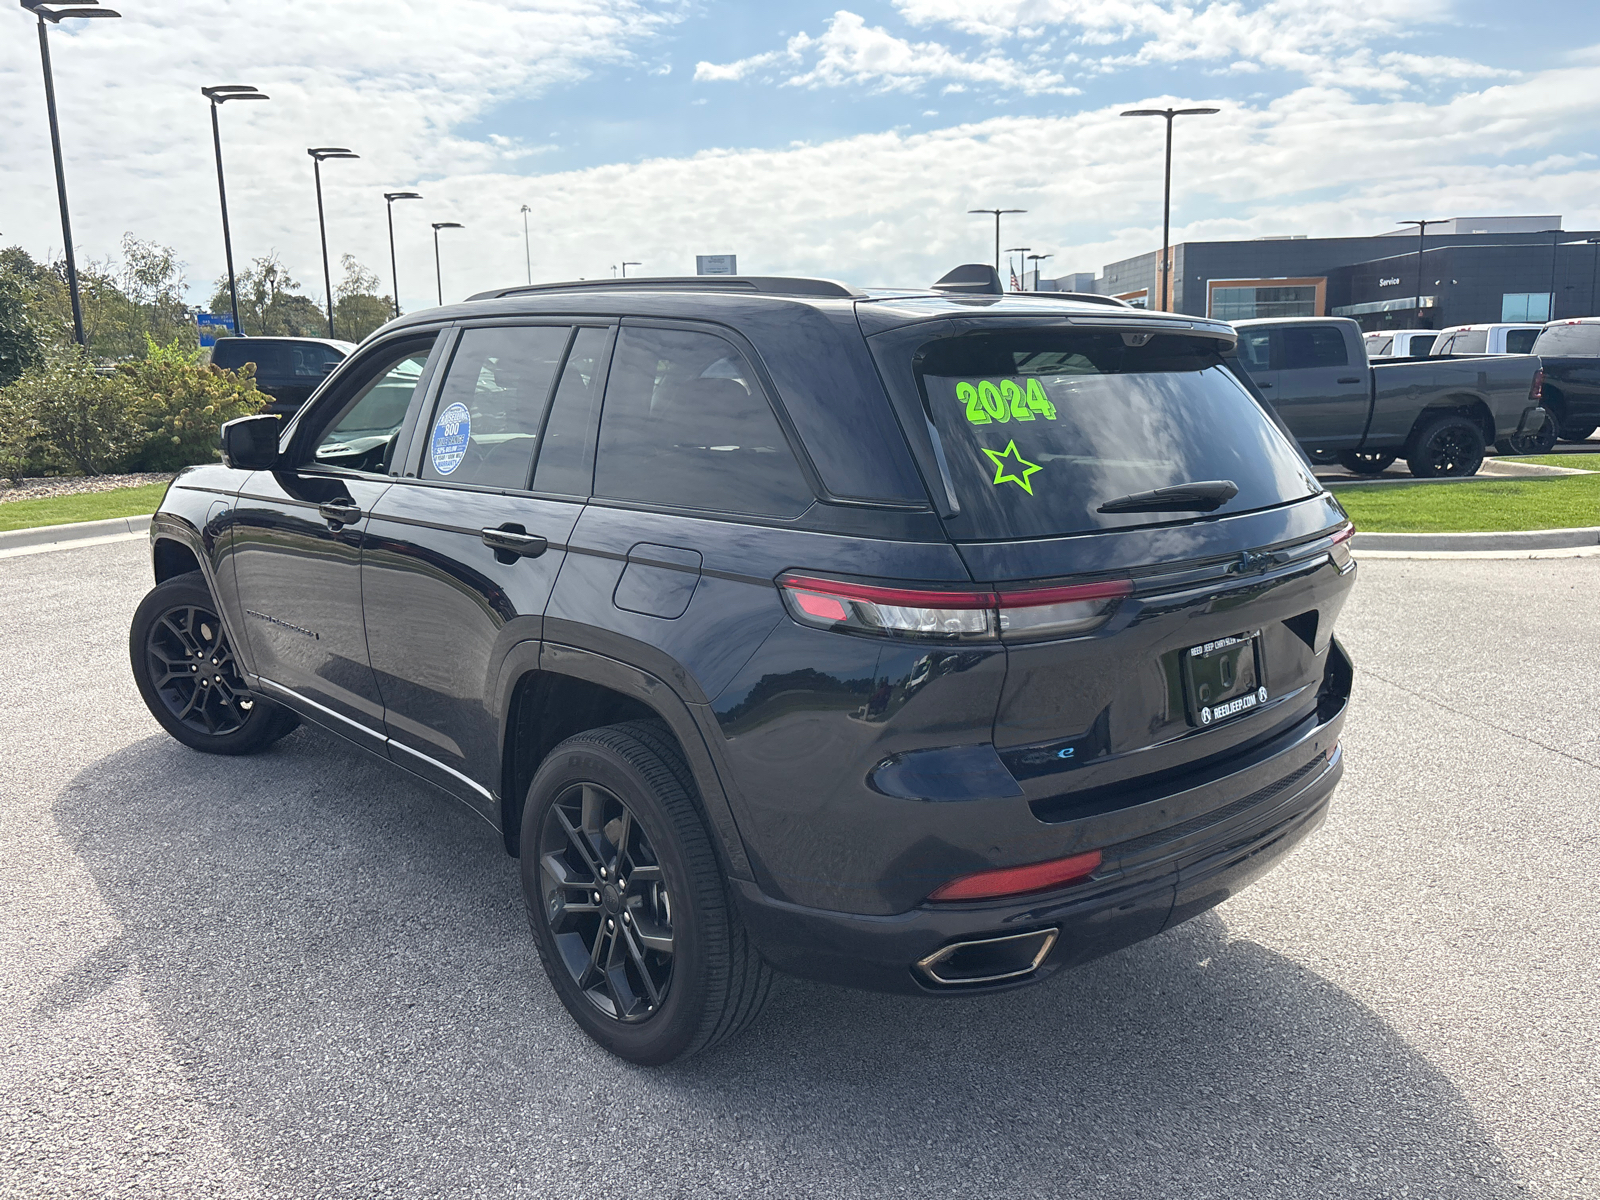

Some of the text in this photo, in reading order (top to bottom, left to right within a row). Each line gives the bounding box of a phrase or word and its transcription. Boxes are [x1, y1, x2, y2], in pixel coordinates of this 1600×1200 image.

[1379, 276, 1400, 287] Service
[956, 378, 1057, 425] 2024
[444, 422, 460, 437] 800
[1190, 637, 1237, 657] REED JEEP CHRYSLER
[1213, 694, 1256, 719] REEDJEEP.COM
